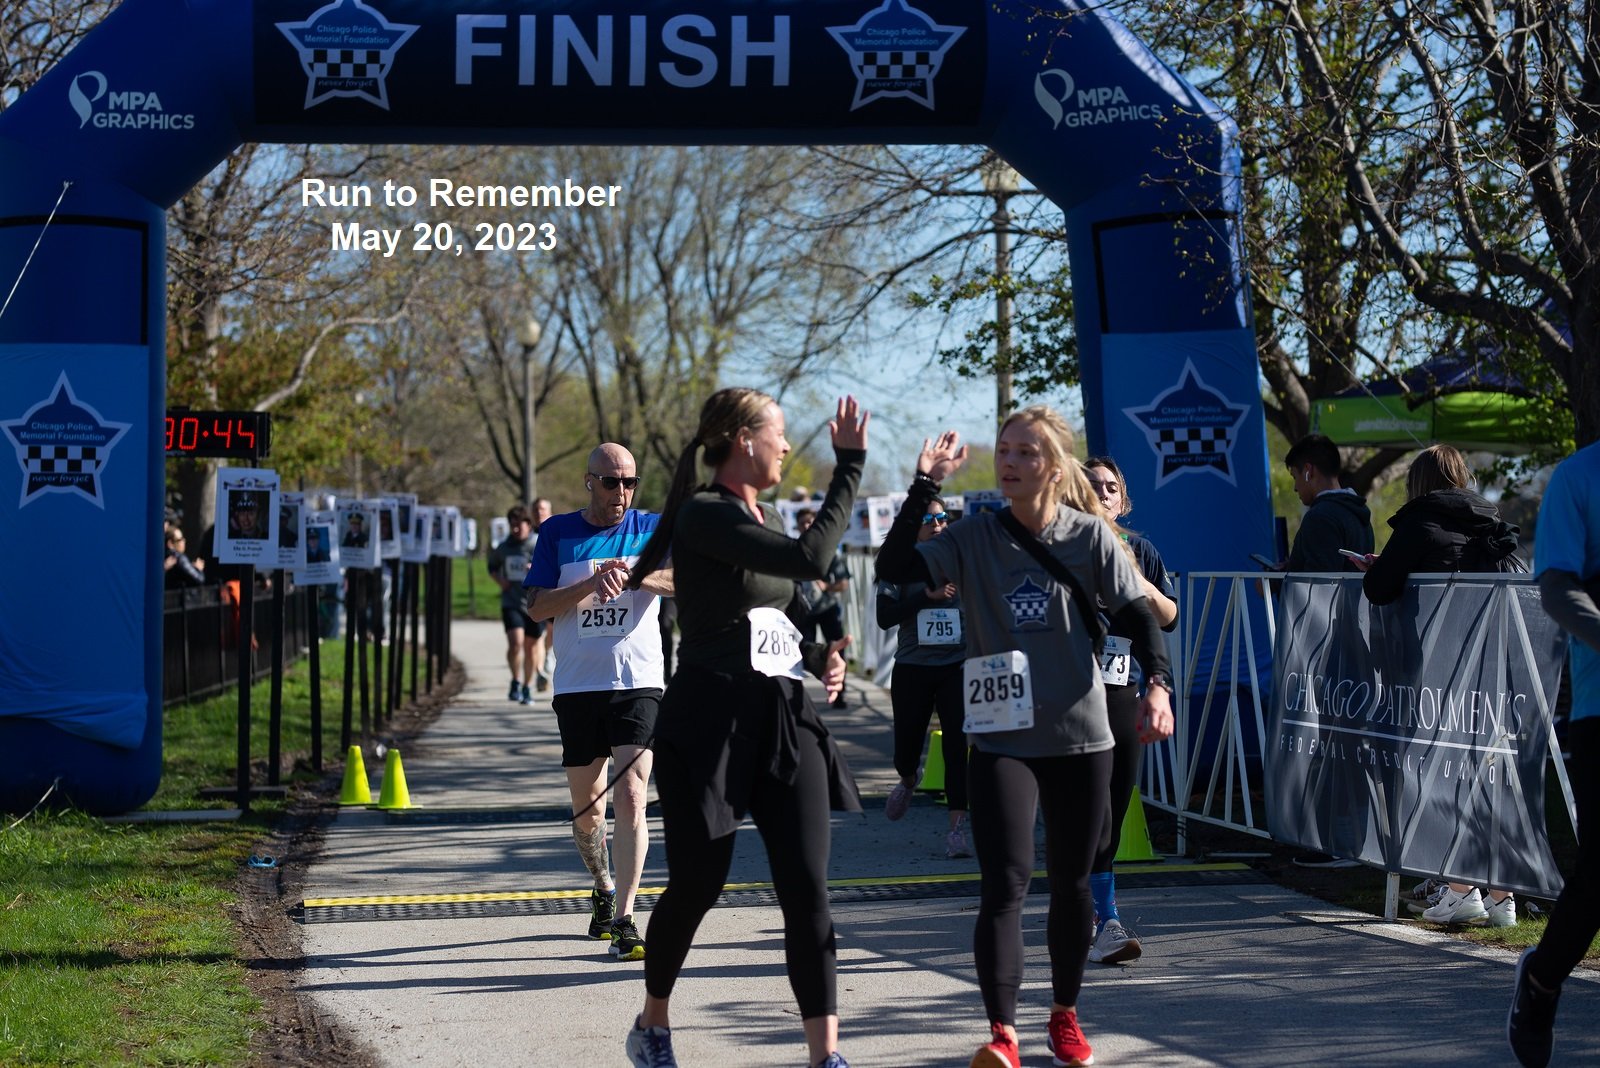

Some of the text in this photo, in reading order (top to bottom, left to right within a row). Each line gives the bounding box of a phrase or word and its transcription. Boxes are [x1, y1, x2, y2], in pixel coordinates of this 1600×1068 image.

[316, 25, 378, 36] Chicago Police
[866, 28, 926, 37] Chicago Police
[304, 35, 390, 44] Memorial Foundation
[855, 38, 939, 46] Memorial Foundation
[455, 14, 790, 88] FINISH
[108, 91, 163, 111] MPA
[1077, 86, 1130, 108] MPA
[93, 112, 195, 130] GRAPHICS
[1065, 104, 1162, 128] GRAPHICS
[1161, 405, 1222, 415] Chicago Police
[31, 422, 93, 431] Chicago Police
[1150, 415, 1233, 425] Memorial Foundation
[20, 431, 106, 441] Memorial Foundation
[59, 474, 90, 484] forget
[582, 608, 629, 628] 2537
[926, 621, 954, 637] 795
[1101, 652, 1126, 674] 73
[969, 673, 1025, 705] 2859
[1285, 672, 1527, 738] CHICAGO PATROLMEN'S
[1279, 734, 1346, 760] FEDERAL
[1356, 745, 1425, 774] CREDIT
